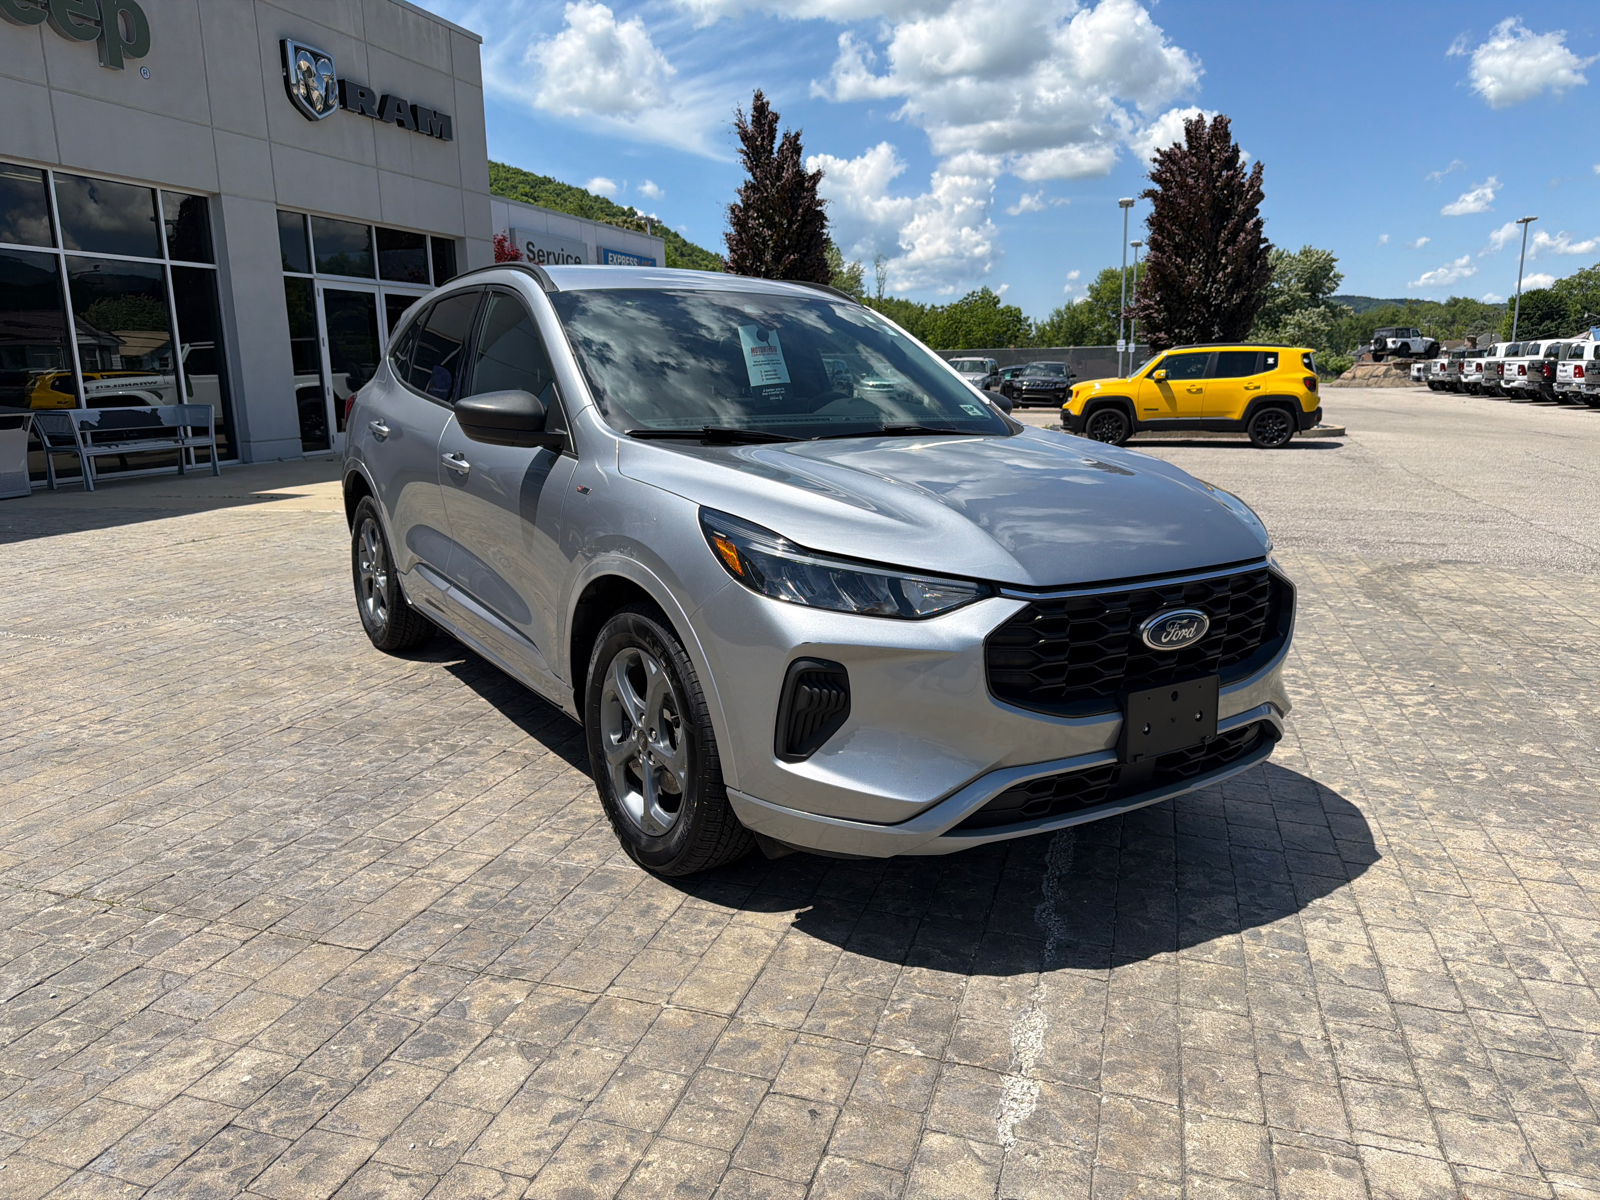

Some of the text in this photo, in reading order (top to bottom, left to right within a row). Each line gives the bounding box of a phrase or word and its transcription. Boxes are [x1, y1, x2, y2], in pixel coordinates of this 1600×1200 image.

[338, 79, 453, 141] RAM
[526, 241, 582, 265] Service
[608, 252, 638, 266] EXPRESS
[1161, 618, 1198, 643] Ford
